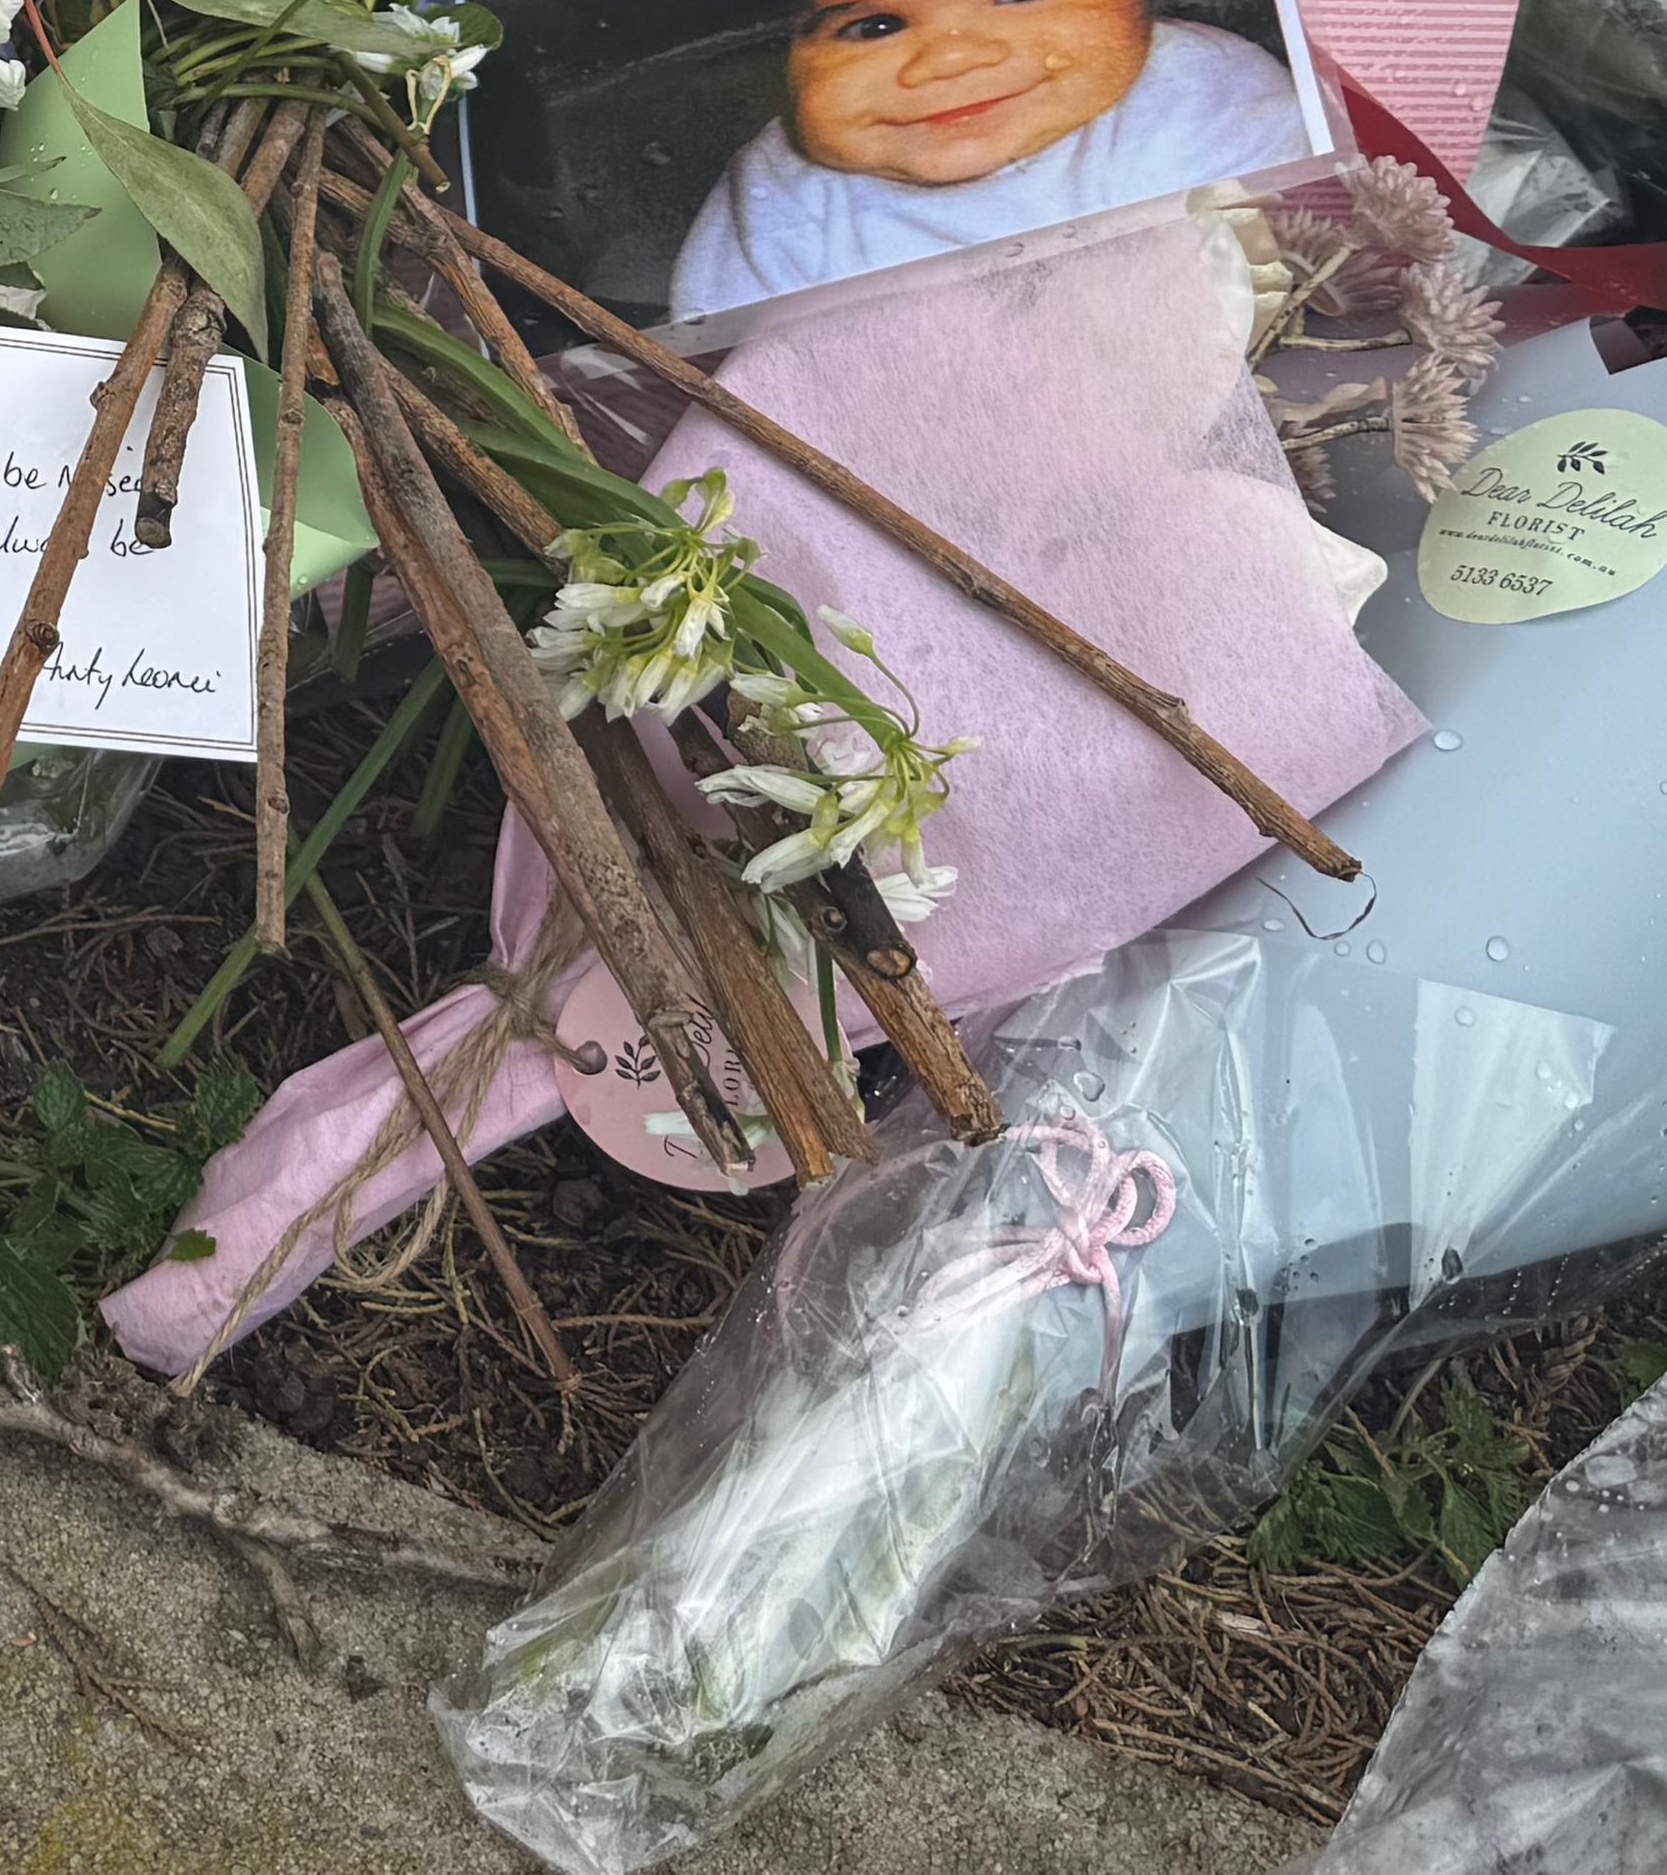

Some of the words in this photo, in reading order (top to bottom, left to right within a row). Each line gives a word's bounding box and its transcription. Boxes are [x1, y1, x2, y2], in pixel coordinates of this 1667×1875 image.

[2, 450, 49, 490] be
[1460, 466, 1533, 506] Dear
[1535, 480, 1666, 540] Delilah
[109, 517, 155, 558] be
[1486, 510, 1586, 542] FLORIST
[1450, 563, 1499, 587] 5133
[1498, 571, 1554, 597] 6537
